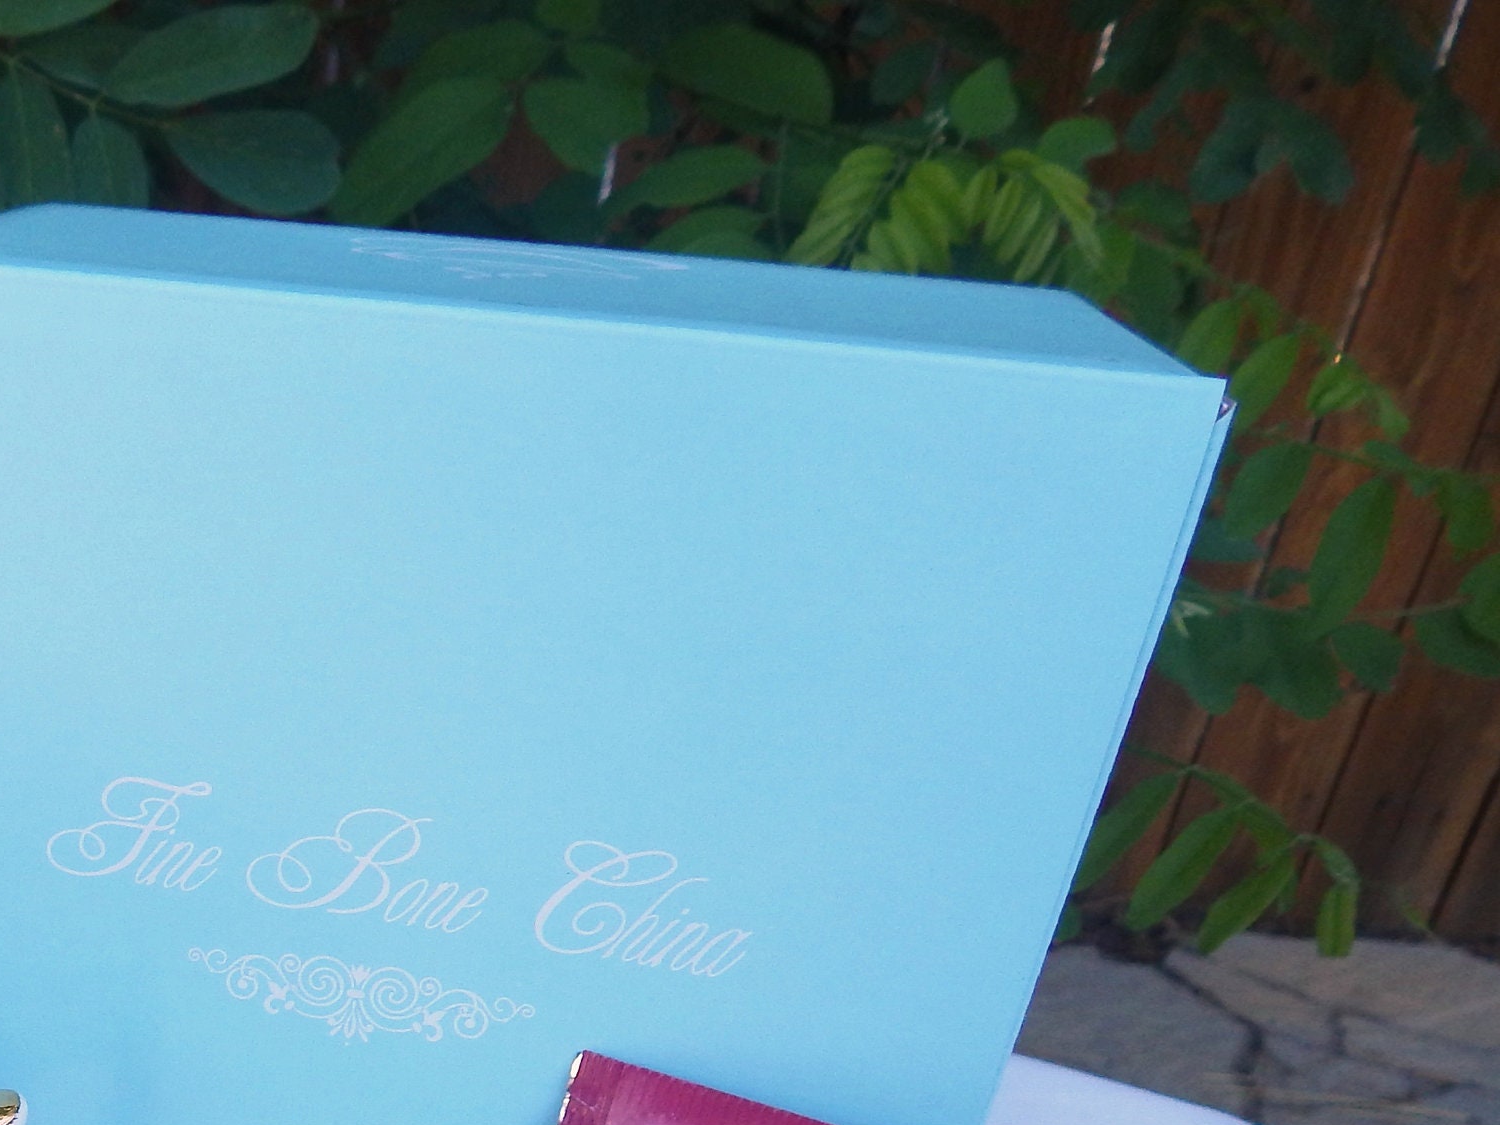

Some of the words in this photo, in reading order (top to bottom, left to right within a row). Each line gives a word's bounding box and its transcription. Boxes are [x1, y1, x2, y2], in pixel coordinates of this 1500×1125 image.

[46, 776, 223, 892] Fine
[246, 808, 489, 933] Bone
[533, 840, 755, 978] China
